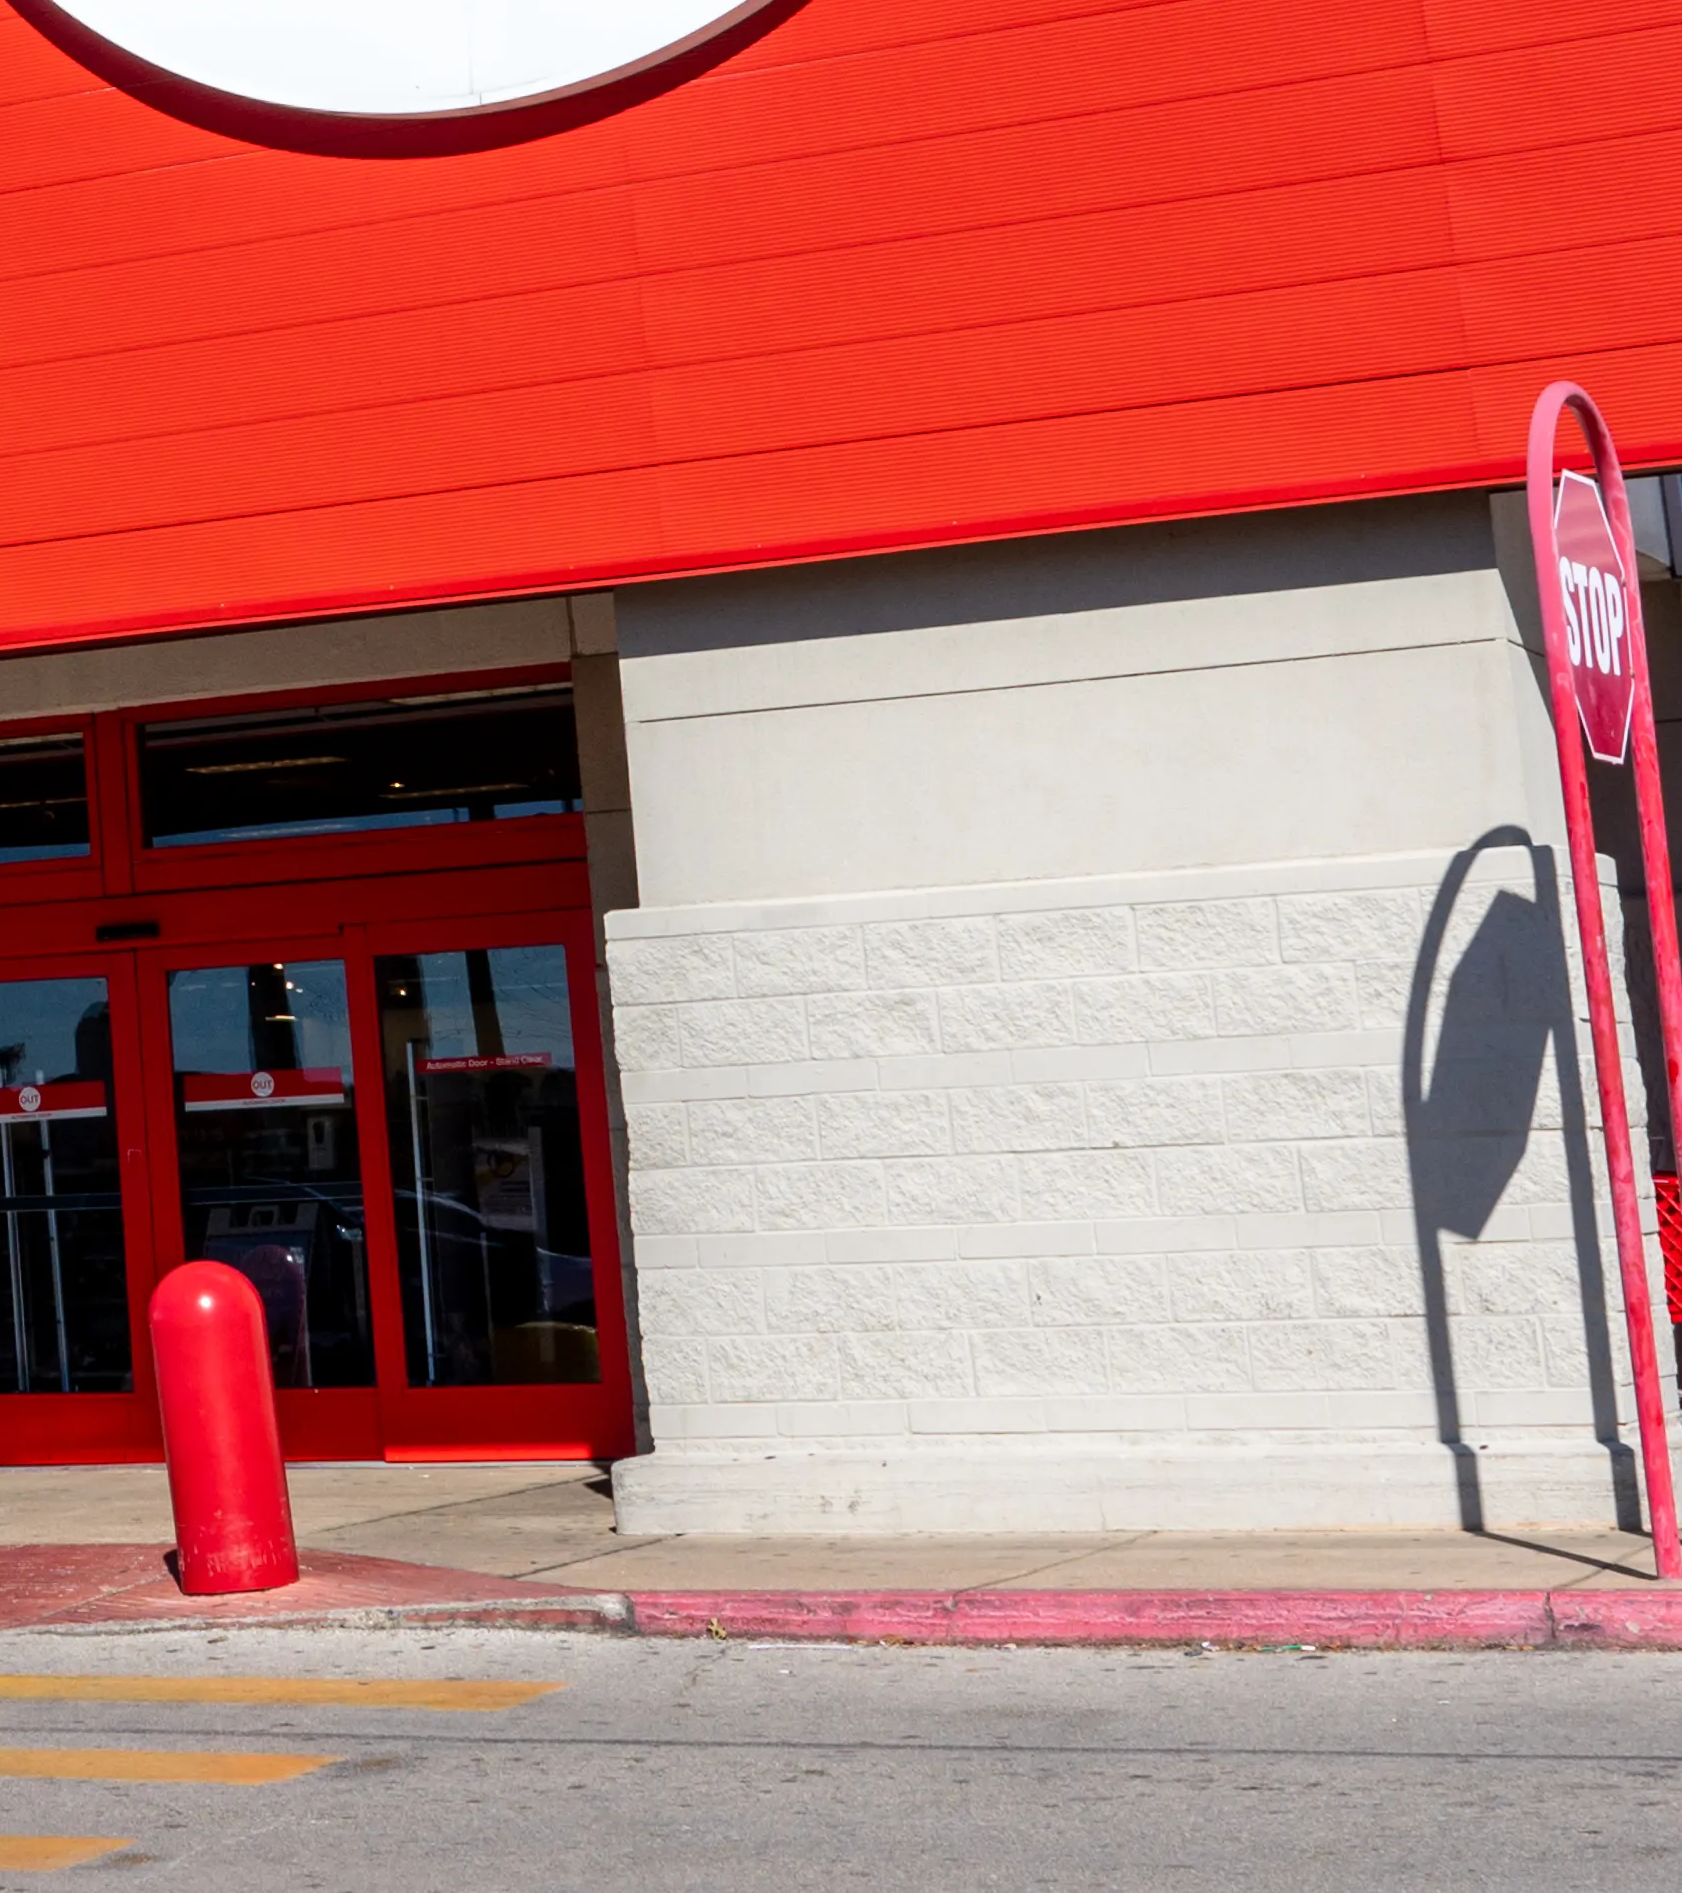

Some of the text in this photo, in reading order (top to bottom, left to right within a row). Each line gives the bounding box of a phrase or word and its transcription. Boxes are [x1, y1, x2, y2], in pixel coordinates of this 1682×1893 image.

[1559, 556, 1624, 677] STOP
[252, 1080, 272, 1090] OUT
[20, 1094, 39, 1104] OUT
